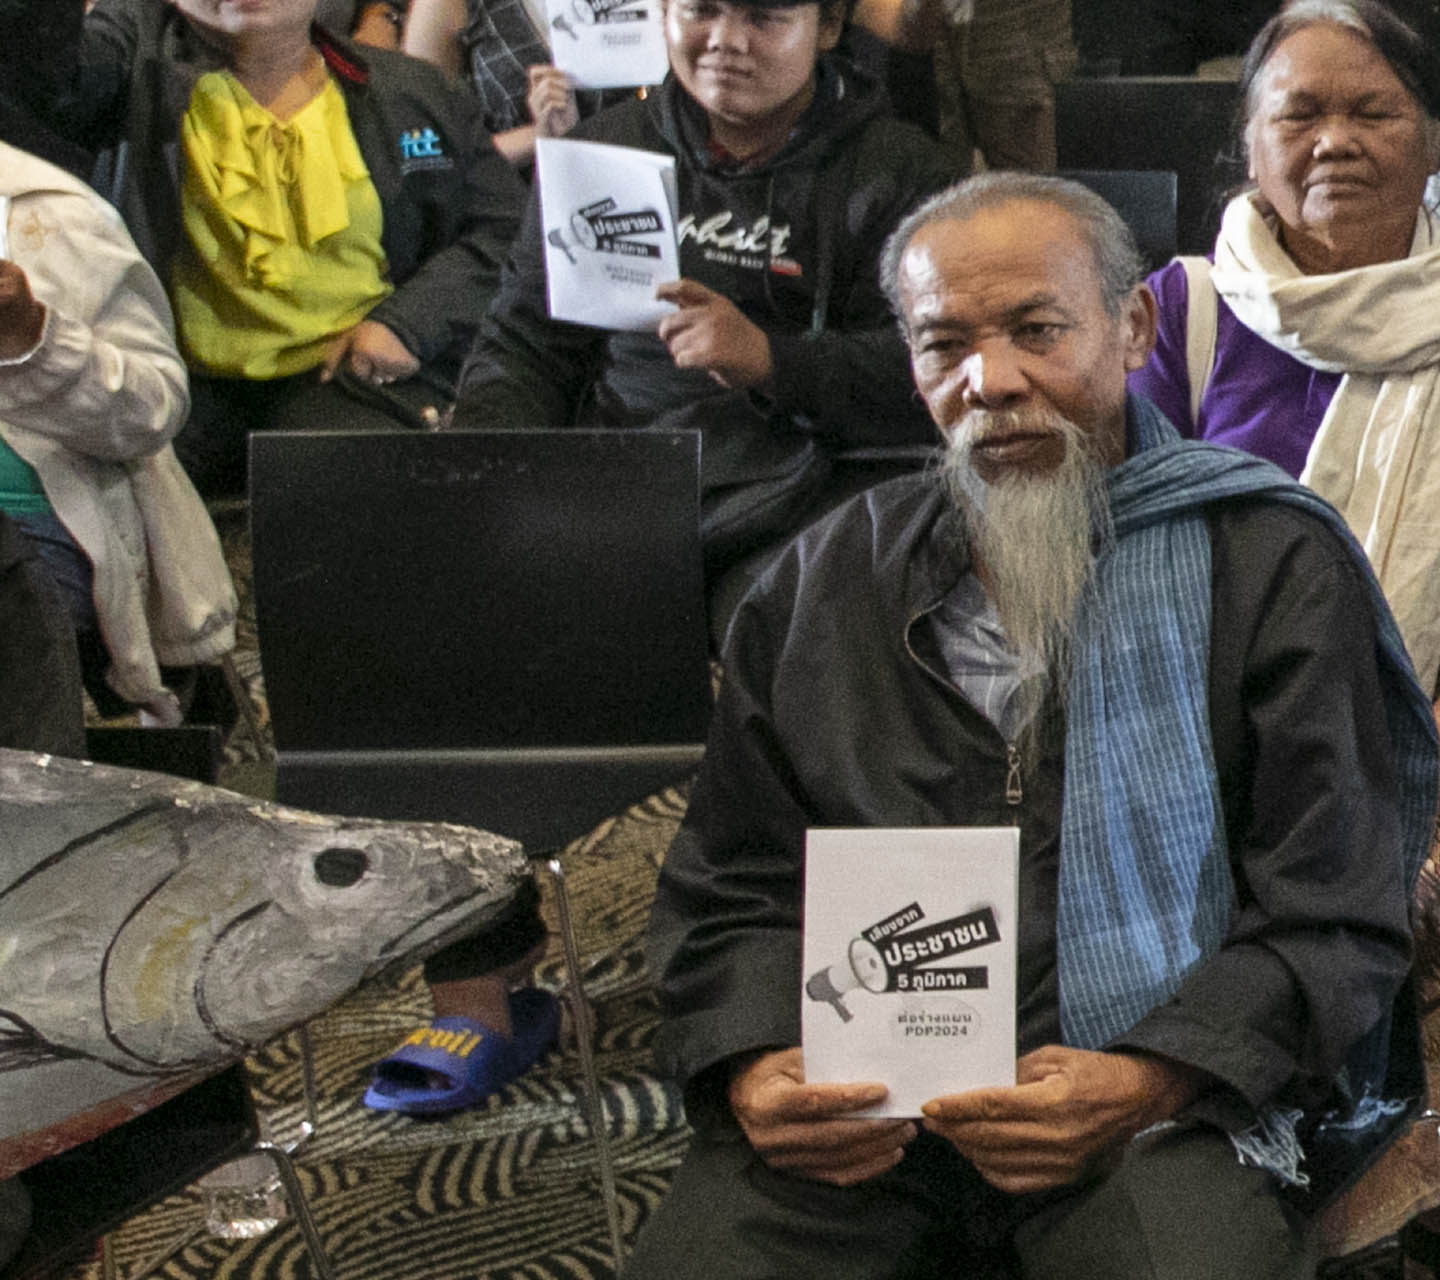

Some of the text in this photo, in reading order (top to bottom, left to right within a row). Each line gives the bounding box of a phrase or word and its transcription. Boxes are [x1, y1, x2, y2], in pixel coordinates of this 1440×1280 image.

[870, 909, 919, 942] เสียงจาก
[886, 921, 988, 966] ประชาชน
[913, 972, 967, 992] ภูมิภาค
[906, 1025, 968, 1037] PDP2024
